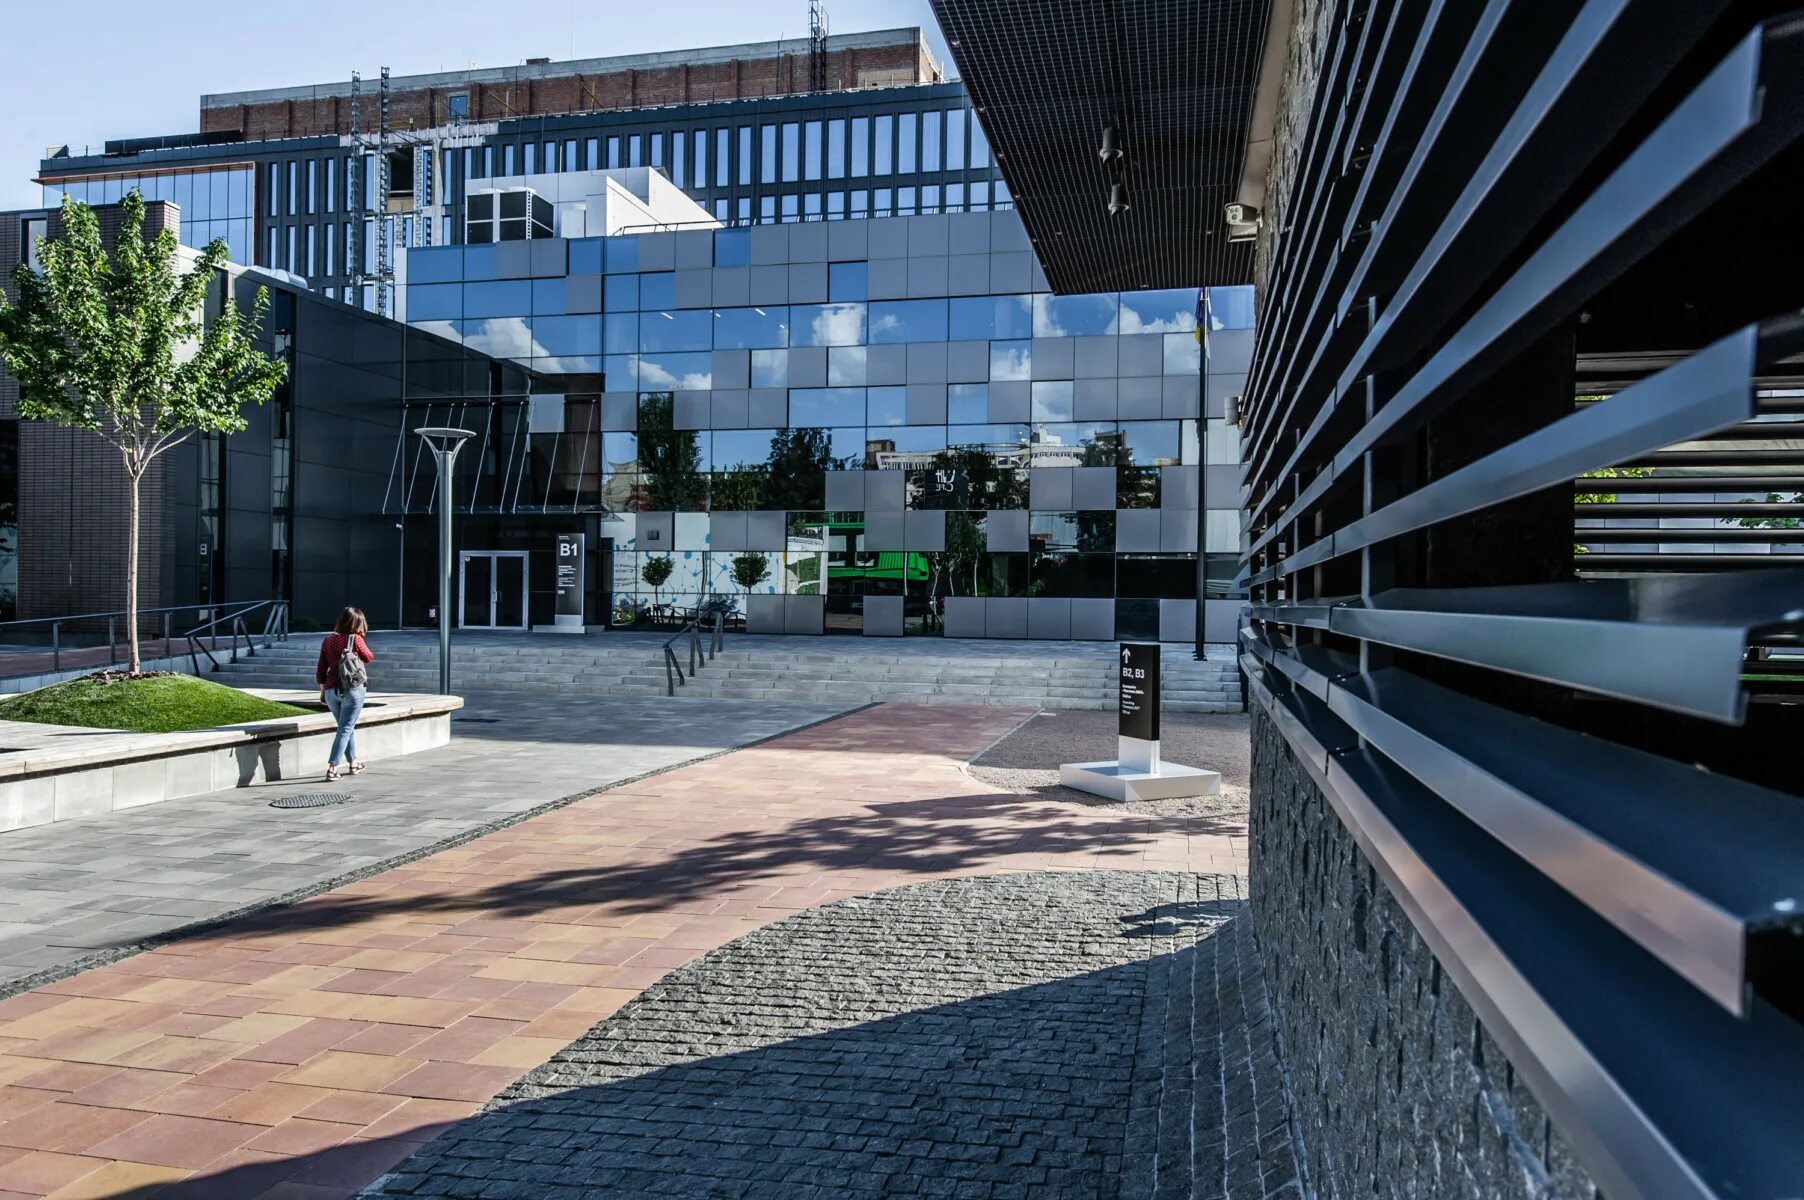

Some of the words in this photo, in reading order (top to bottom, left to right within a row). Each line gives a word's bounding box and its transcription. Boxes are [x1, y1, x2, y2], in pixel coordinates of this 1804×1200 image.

[560, 543, 578, 557] B1
[1122, 667, 1134, 679] B2,
[1135, 668, 1145, 679] B3
